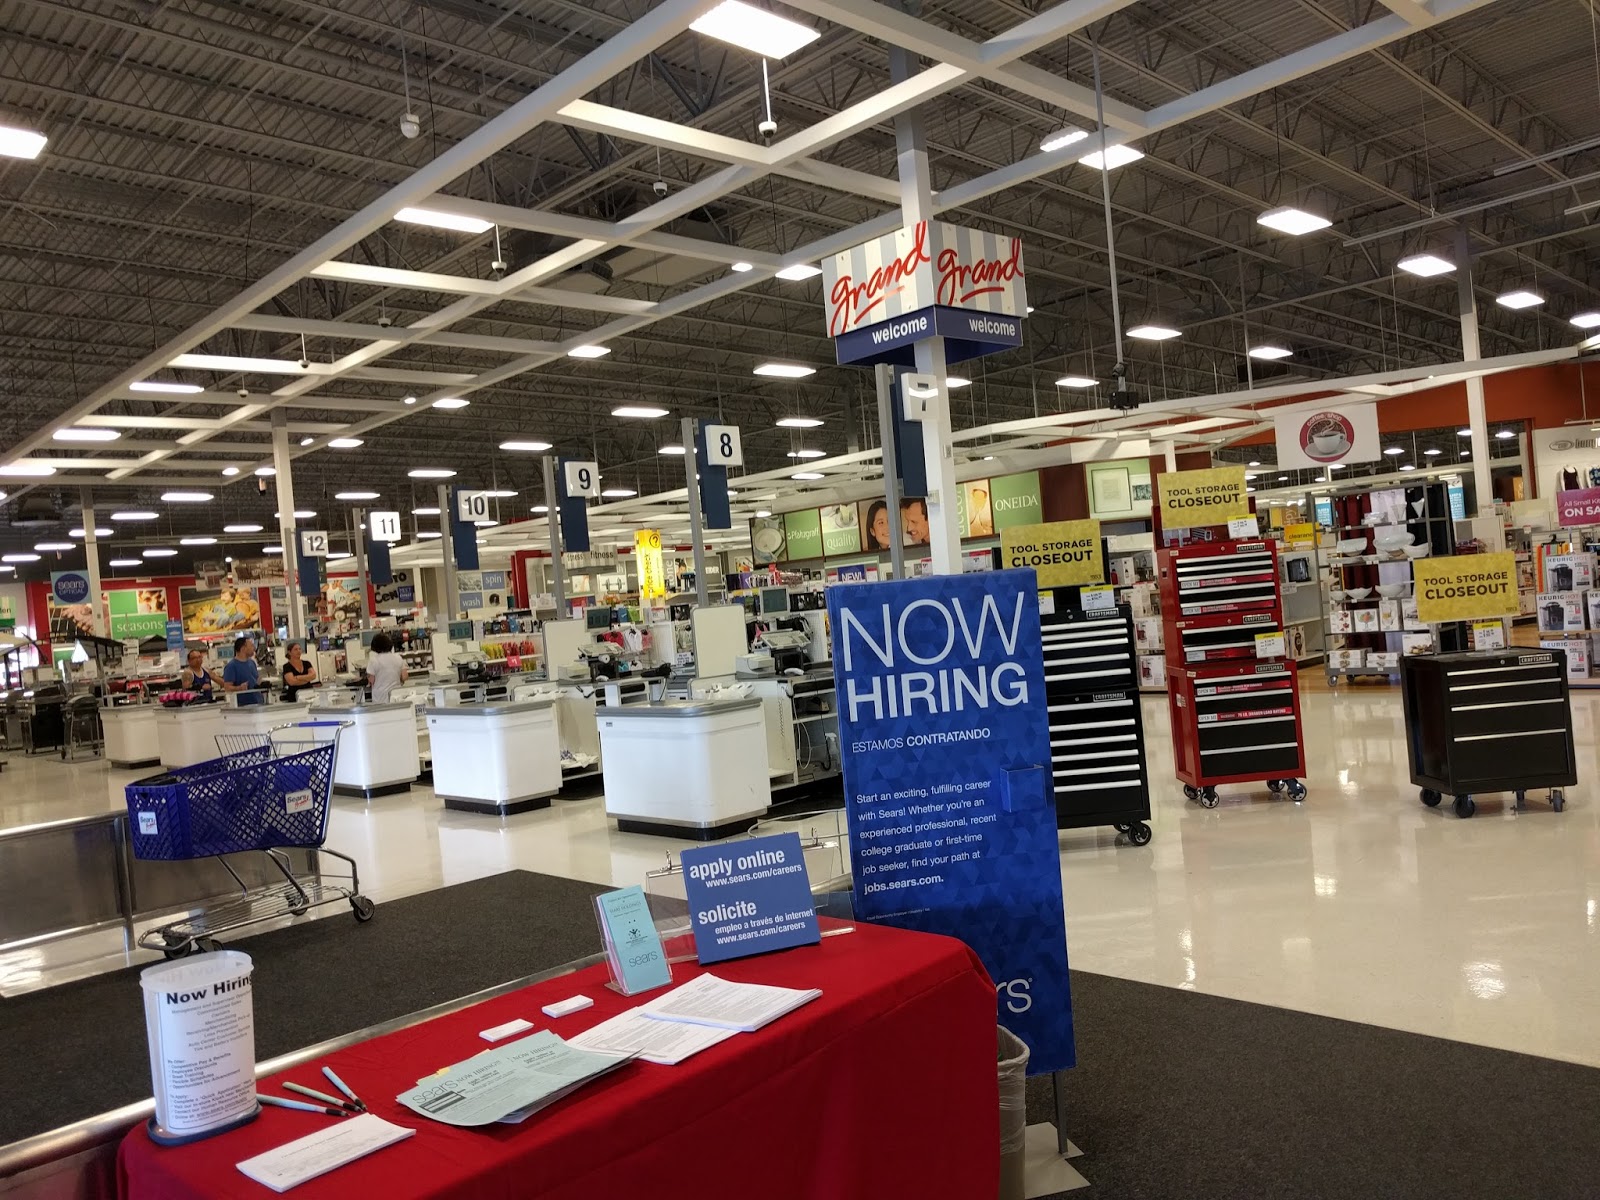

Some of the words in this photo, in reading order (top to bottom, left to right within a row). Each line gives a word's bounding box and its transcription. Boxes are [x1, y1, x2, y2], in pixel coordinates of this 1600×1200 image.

[830, 220, 931, 336] grand
[937, 238, 1024, 307] grand
[872, 316, 928, 344] welcome
[968, 317, 1016, 337] welcome
[1306, 413, 1325, 426] coffee
[720, 432, 732, 458] 8
[578, 468, 591, 490] 9
[1167, 488, 1192, 497] TOOL
[1195, 484, 1240, 494] STORAGE
[1168, 493, 1241, 509] CLOSEOUT
[465, 494, 485, 516] 10
[995, 495, 1038, 512] ONEIDA
[1564, 508, 1583, 517] ON
[379, 518, 396, 535] 11
[307, 535, 324, 551] 12
[1010, 544, 1040, 554] TOOL
[1042, 539, 1093, 551] STORAGE
[590, 551, 614, 559] fitness
[1011, 550, 1094, 568] CLOSEOUT
[57, 581, 85, 589] sears
[485, 575, 502, 586] spin
[841, 571, 866, 582] NEW!
[1423, 577, 1453, 586] TOOL
[1456, 571, 1508, 584] STORAGE
[1425, 582, 1509, 600] CLOSEOUT
[462, 597, 481, 607] wash
[117, 621, 164, 632] seasons
[839, 591, 1025, 672] NOW
[846, 662, 1029, 723] HIRING
[852, 738, 904, 753] ESTAMOS
[906, 728, 991, 747] CONTRATANDO
[856, 793, 878, 804] Start
[880, 792, 891, 801] an
[893, 787, 929, 800] exciting,
[931, 782, 963, 796] fulfilling
[964, 779, 992, 791] career
[858, 811, 876, 821] with
[878, 808, 906, 819] Sears!
[908, 803, 943, 816] Whether
[946, 800, 972, 812] you're
[973, 798, 985, 807] an
[859, 824, 913, 840] experienced
[914, 817, 968, 833] professional,
[970, 813, 997, 824] recent
[861, 843, 893, 857] college
[894, 839, 932, 854] graduate
[934, 837, 943, 846] or
[945, 833, 983, 845] first-time
[689, 857, 733, 881] apply
[737, 850, 785, 871] online
[862, 865, 876, 877] job
[879, 861, 909, 872] seeker,
[911, 857, 928, 868] find
[930, 856, 949, 868] your
[951, 852, 970, 864] path
[971, 850, 981, 859] at
[705, 864, 802, 888] www.sears.com/careers
[863, 874, 944, 895] jobs.sears.com.
[698, 900, 757, 925] solicite
[714, 923, 743, 936] empleo
[750, 915, 773, 928] través
[774, 914, 784, 924] de
[785, 909, 814, 922] internet
[716, 921, 806, 945] www.sears.com/careers
[628, 950, 658, 968] sears
[167, 988, 208, 1005] Now
[412, 1080, 459, 1104] sears
